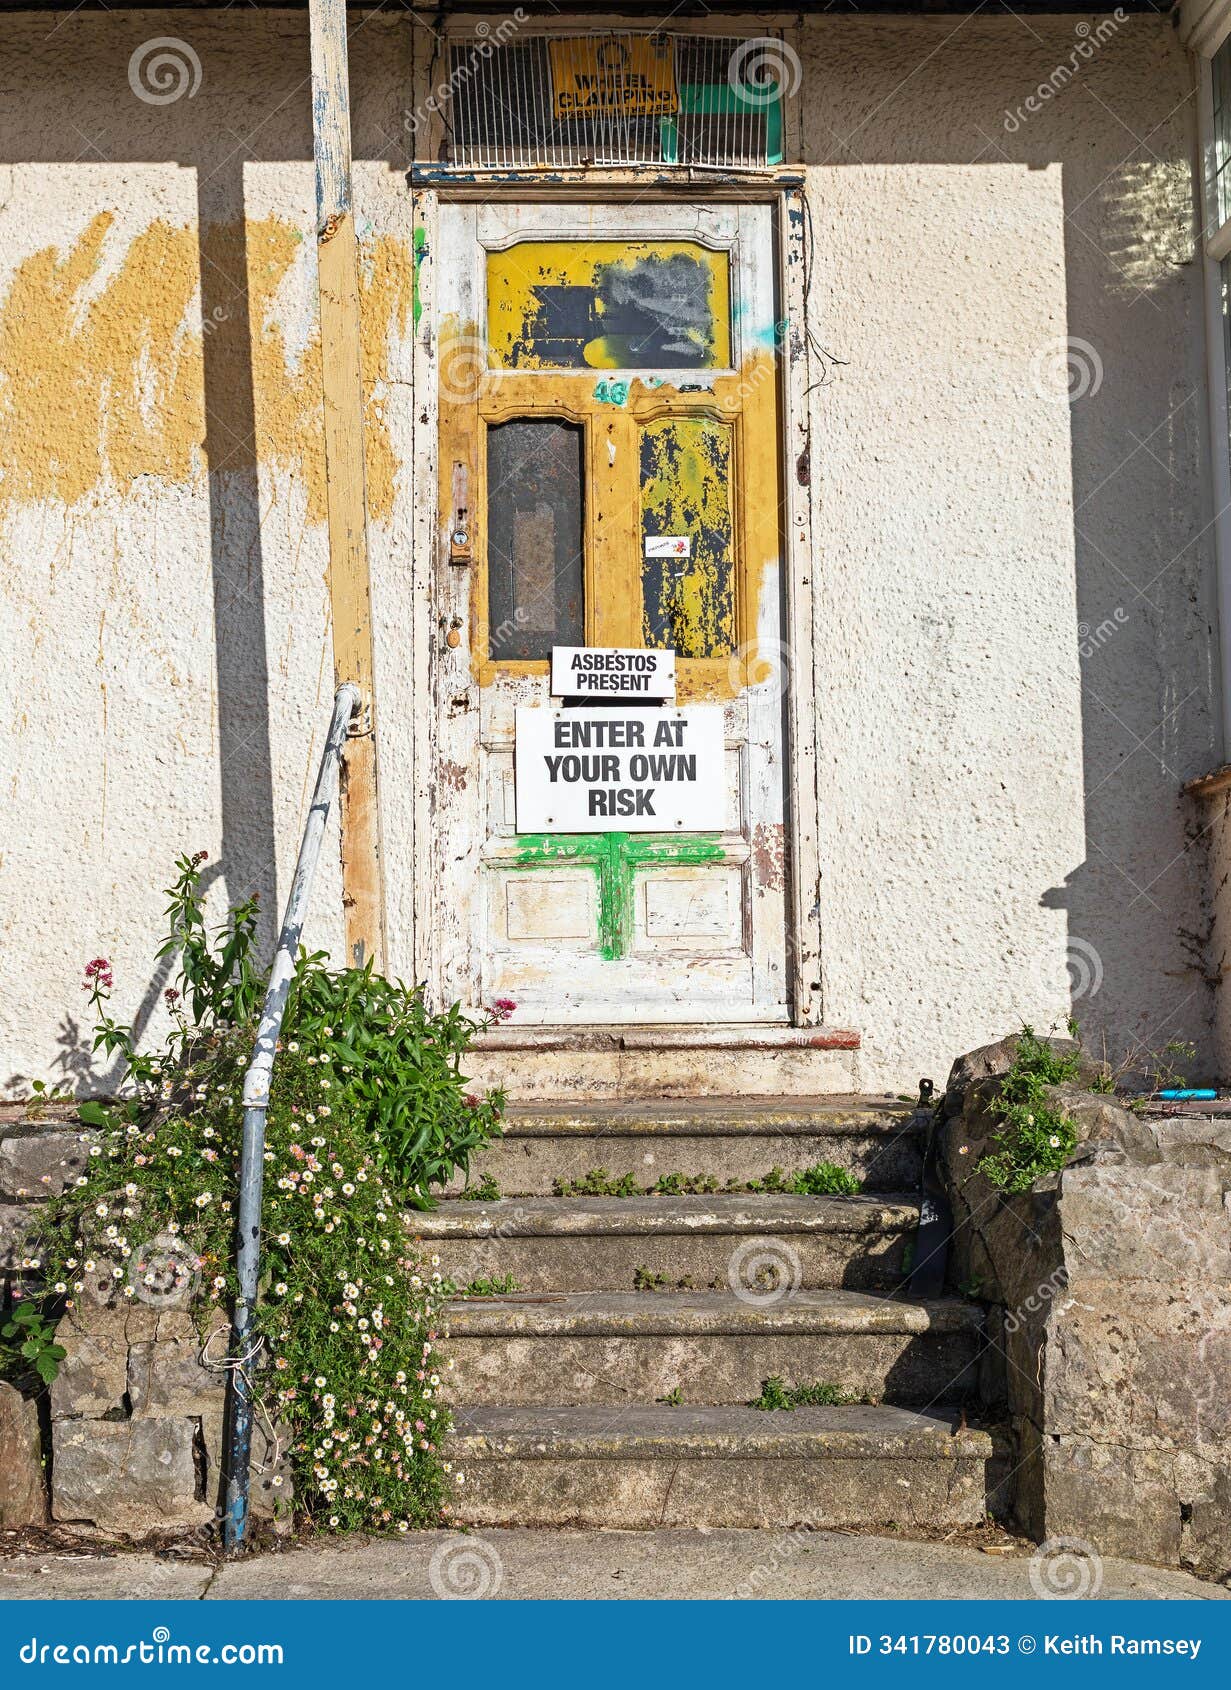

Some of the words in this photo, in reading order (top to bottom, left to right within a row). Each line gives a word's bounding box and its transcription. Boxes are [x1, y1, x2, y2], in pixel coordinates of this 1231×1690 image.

[574, 73, 653, 90] WHEEL
[558, 89, 672, 109] CLAMPING
[650, 102, 675, 113] AREA
[571, 653, 657, 672] ASBESTOS
[576, 673, 652, 691] PRESENT
[554, 720, 646, 748] ENTER
[653, 720, 688, 747] AT
[543, 755, 620, 782] YOUR
[629, 754, 697, 781] OWN
[588, 788, 656, 816] RISK
